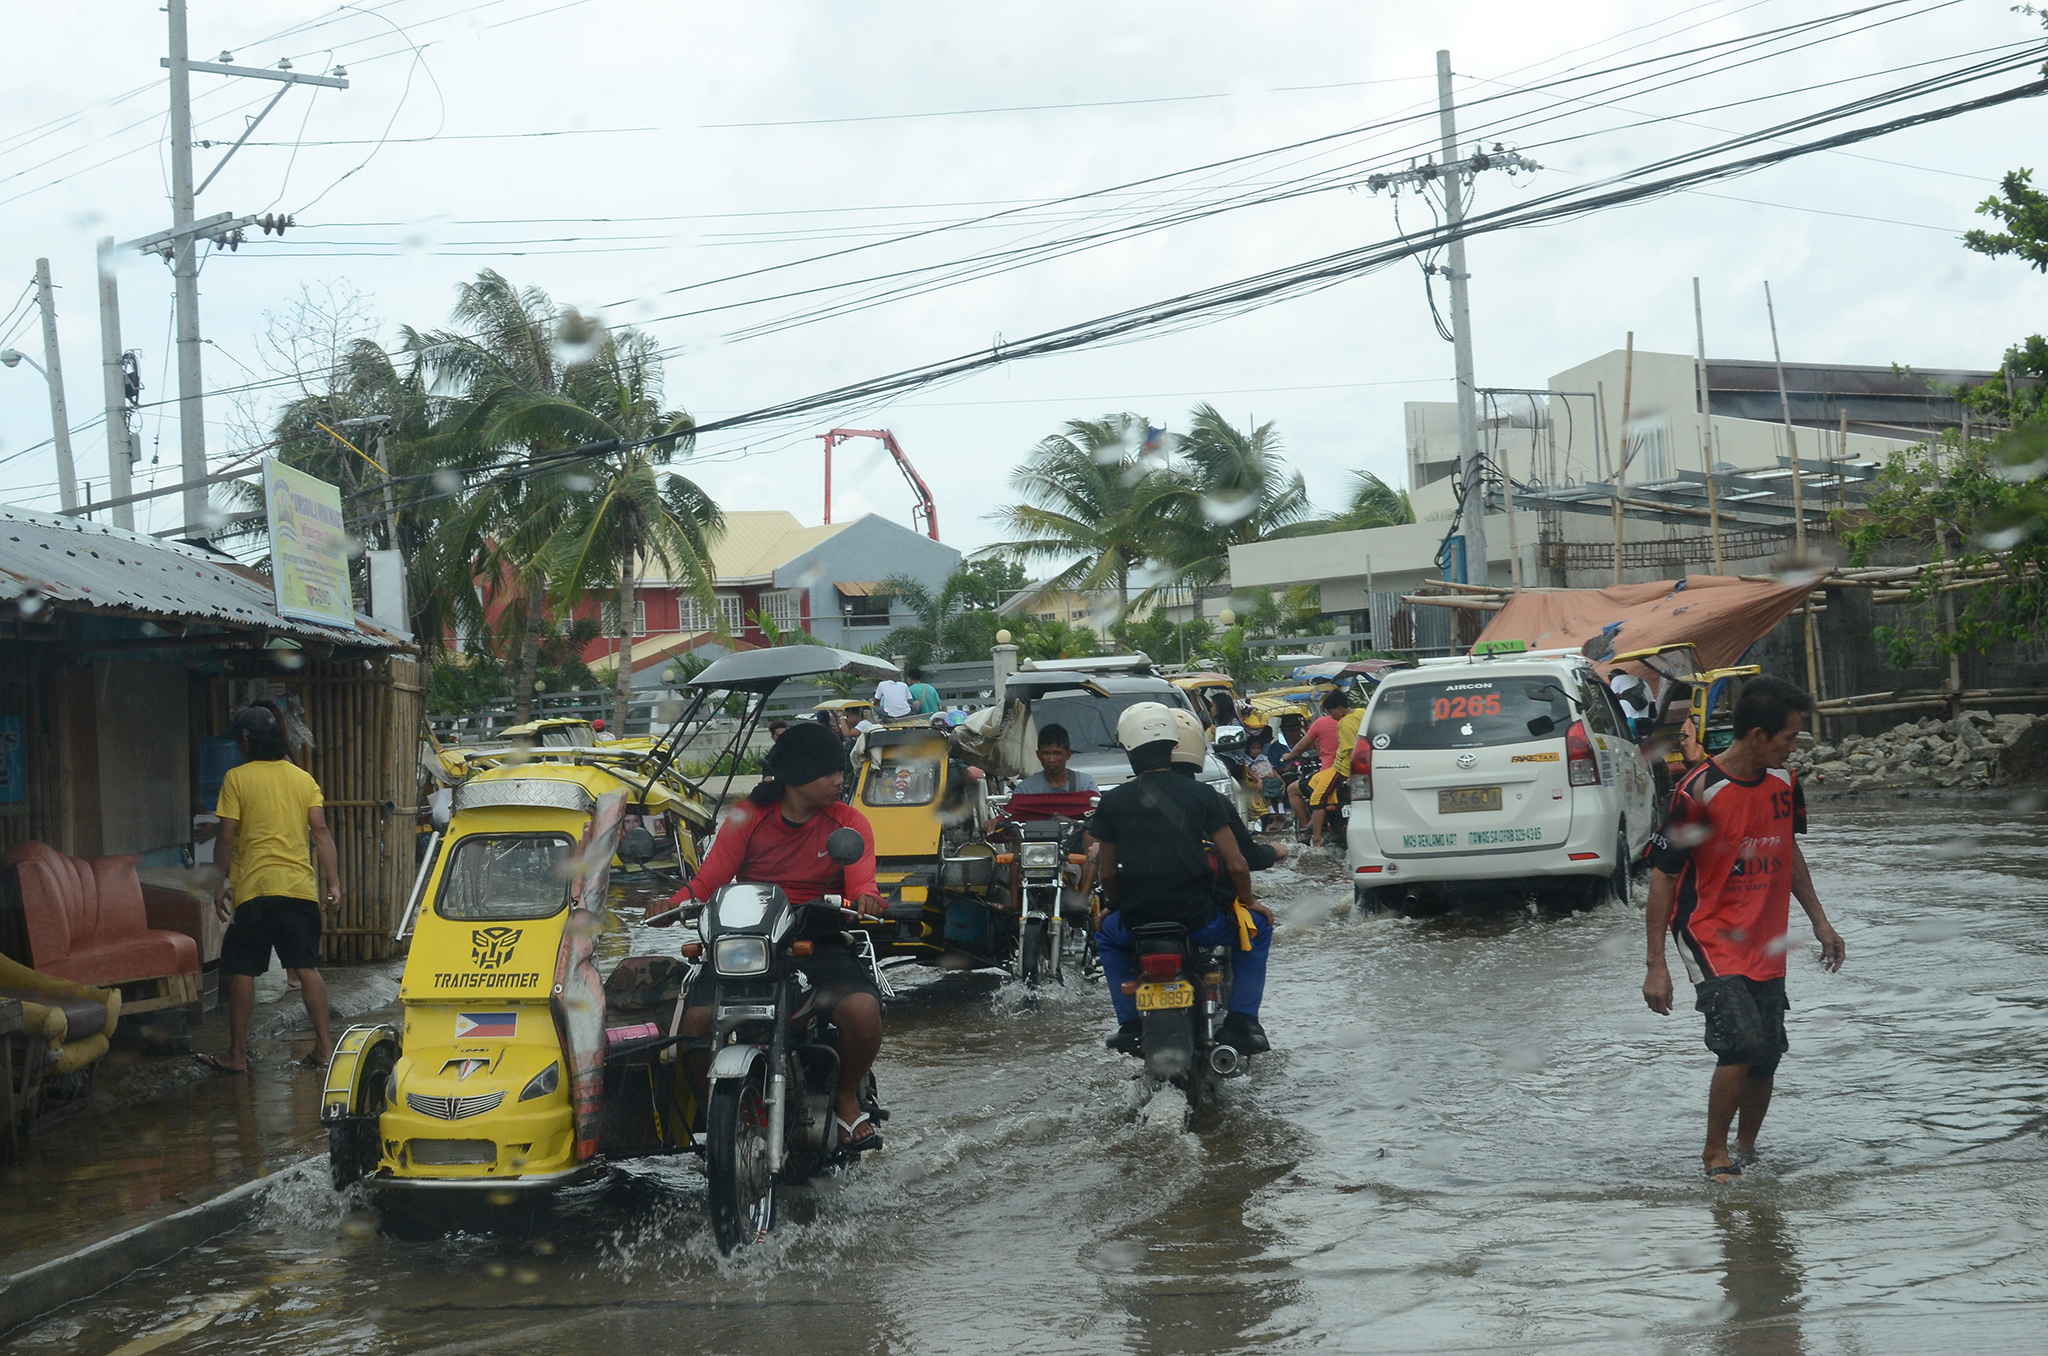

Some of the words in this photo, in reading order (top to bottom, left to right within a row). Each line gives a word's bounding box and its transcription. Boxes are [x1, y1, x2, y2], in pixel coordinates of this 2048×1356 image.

[1484, 642, 1515, 651] TAXI
[1446, 682, 1492, 692] AIRCON
[1435, 694, 1501, 720] 0265
[1511, 754, 1537, 763] FAKE
[1538, 752, 1559, 762] TAXI
[1771, 790, 1791, 819] 15
[1748, 854, 1781, 875] DBS
[434, 973, 539, 988] TRANSFORMER
